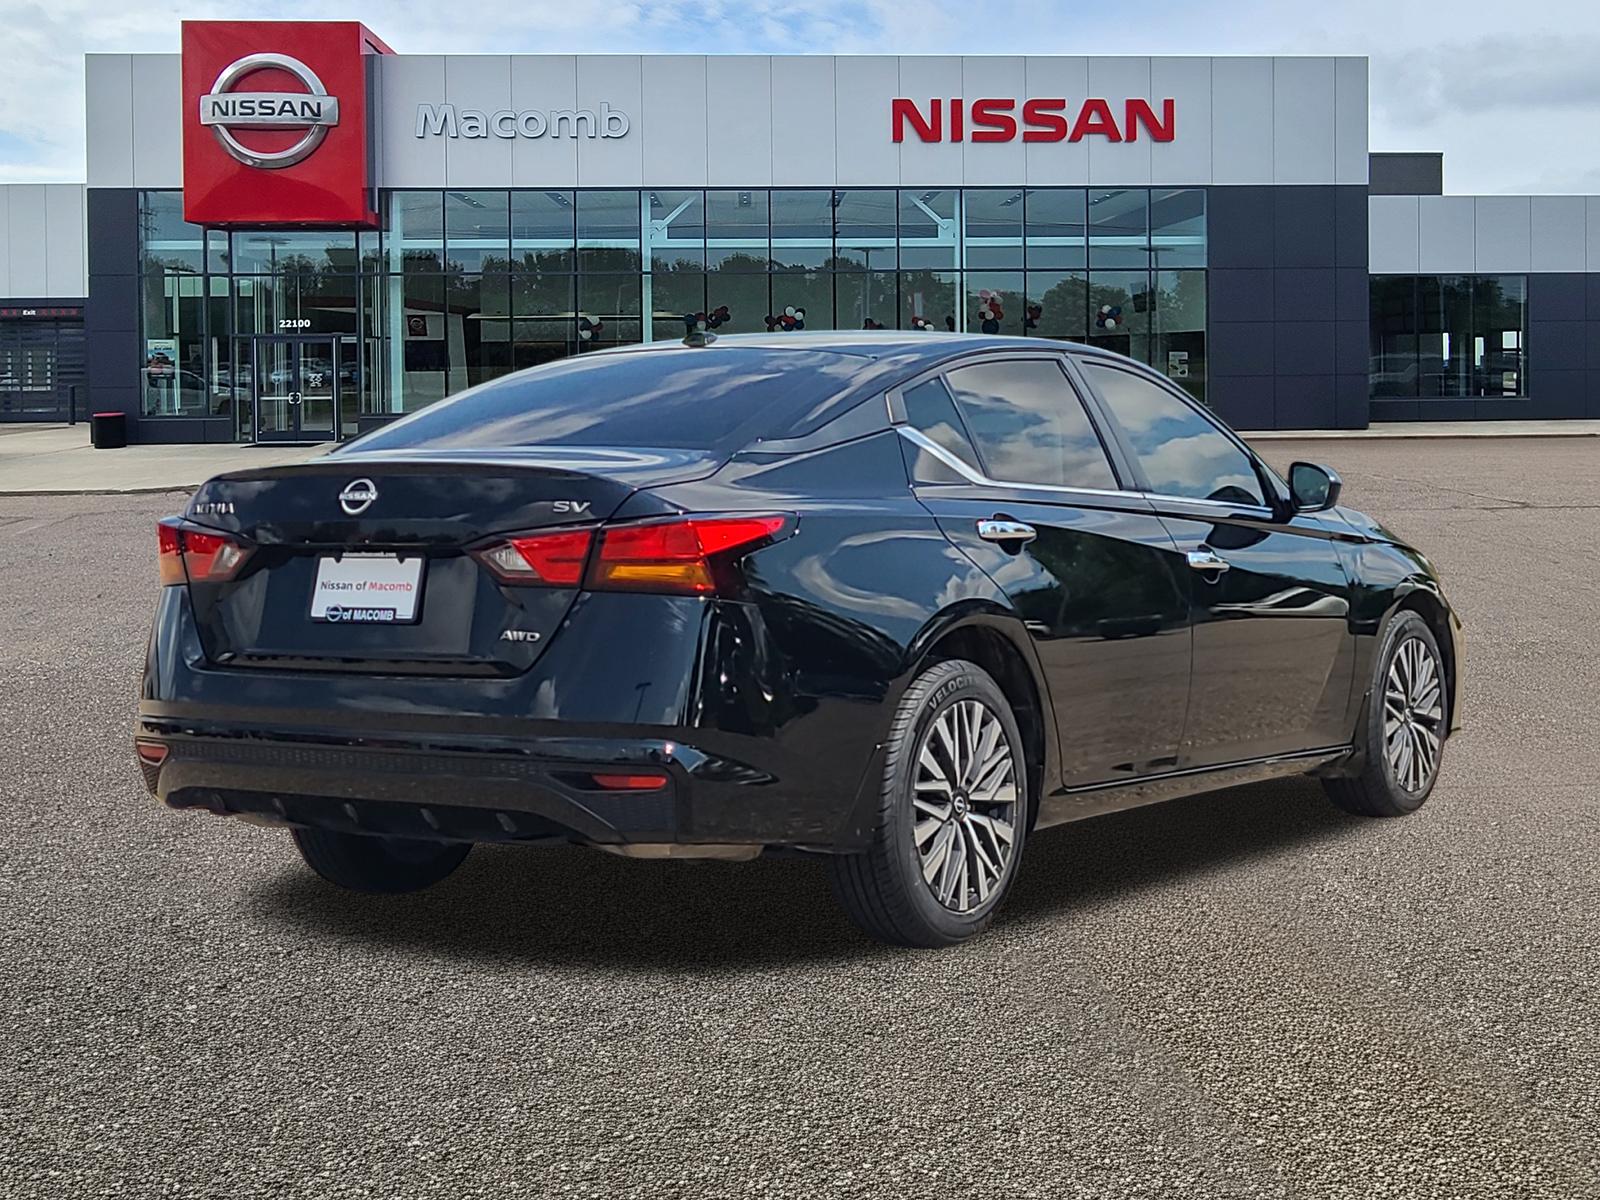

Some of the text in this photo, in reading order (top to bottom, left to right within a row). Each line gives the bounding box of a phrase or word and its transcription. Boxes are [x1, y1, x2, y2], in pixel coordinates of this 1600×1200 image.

[212, 100, 322, 118] NISSAN
[415, 101, 630, 139] Macomb
[892, 98, 1175, 143] NISSAN
[279, 319, 311, 328] 22100
[552, 500, 591, 513] SV
[320, 580, 413, 592] Nissan of Macomb
[342, 609, 353, 620] of
[353, 609, 394, 621] MACOMB
[499, 630, 541, 642] AWD
